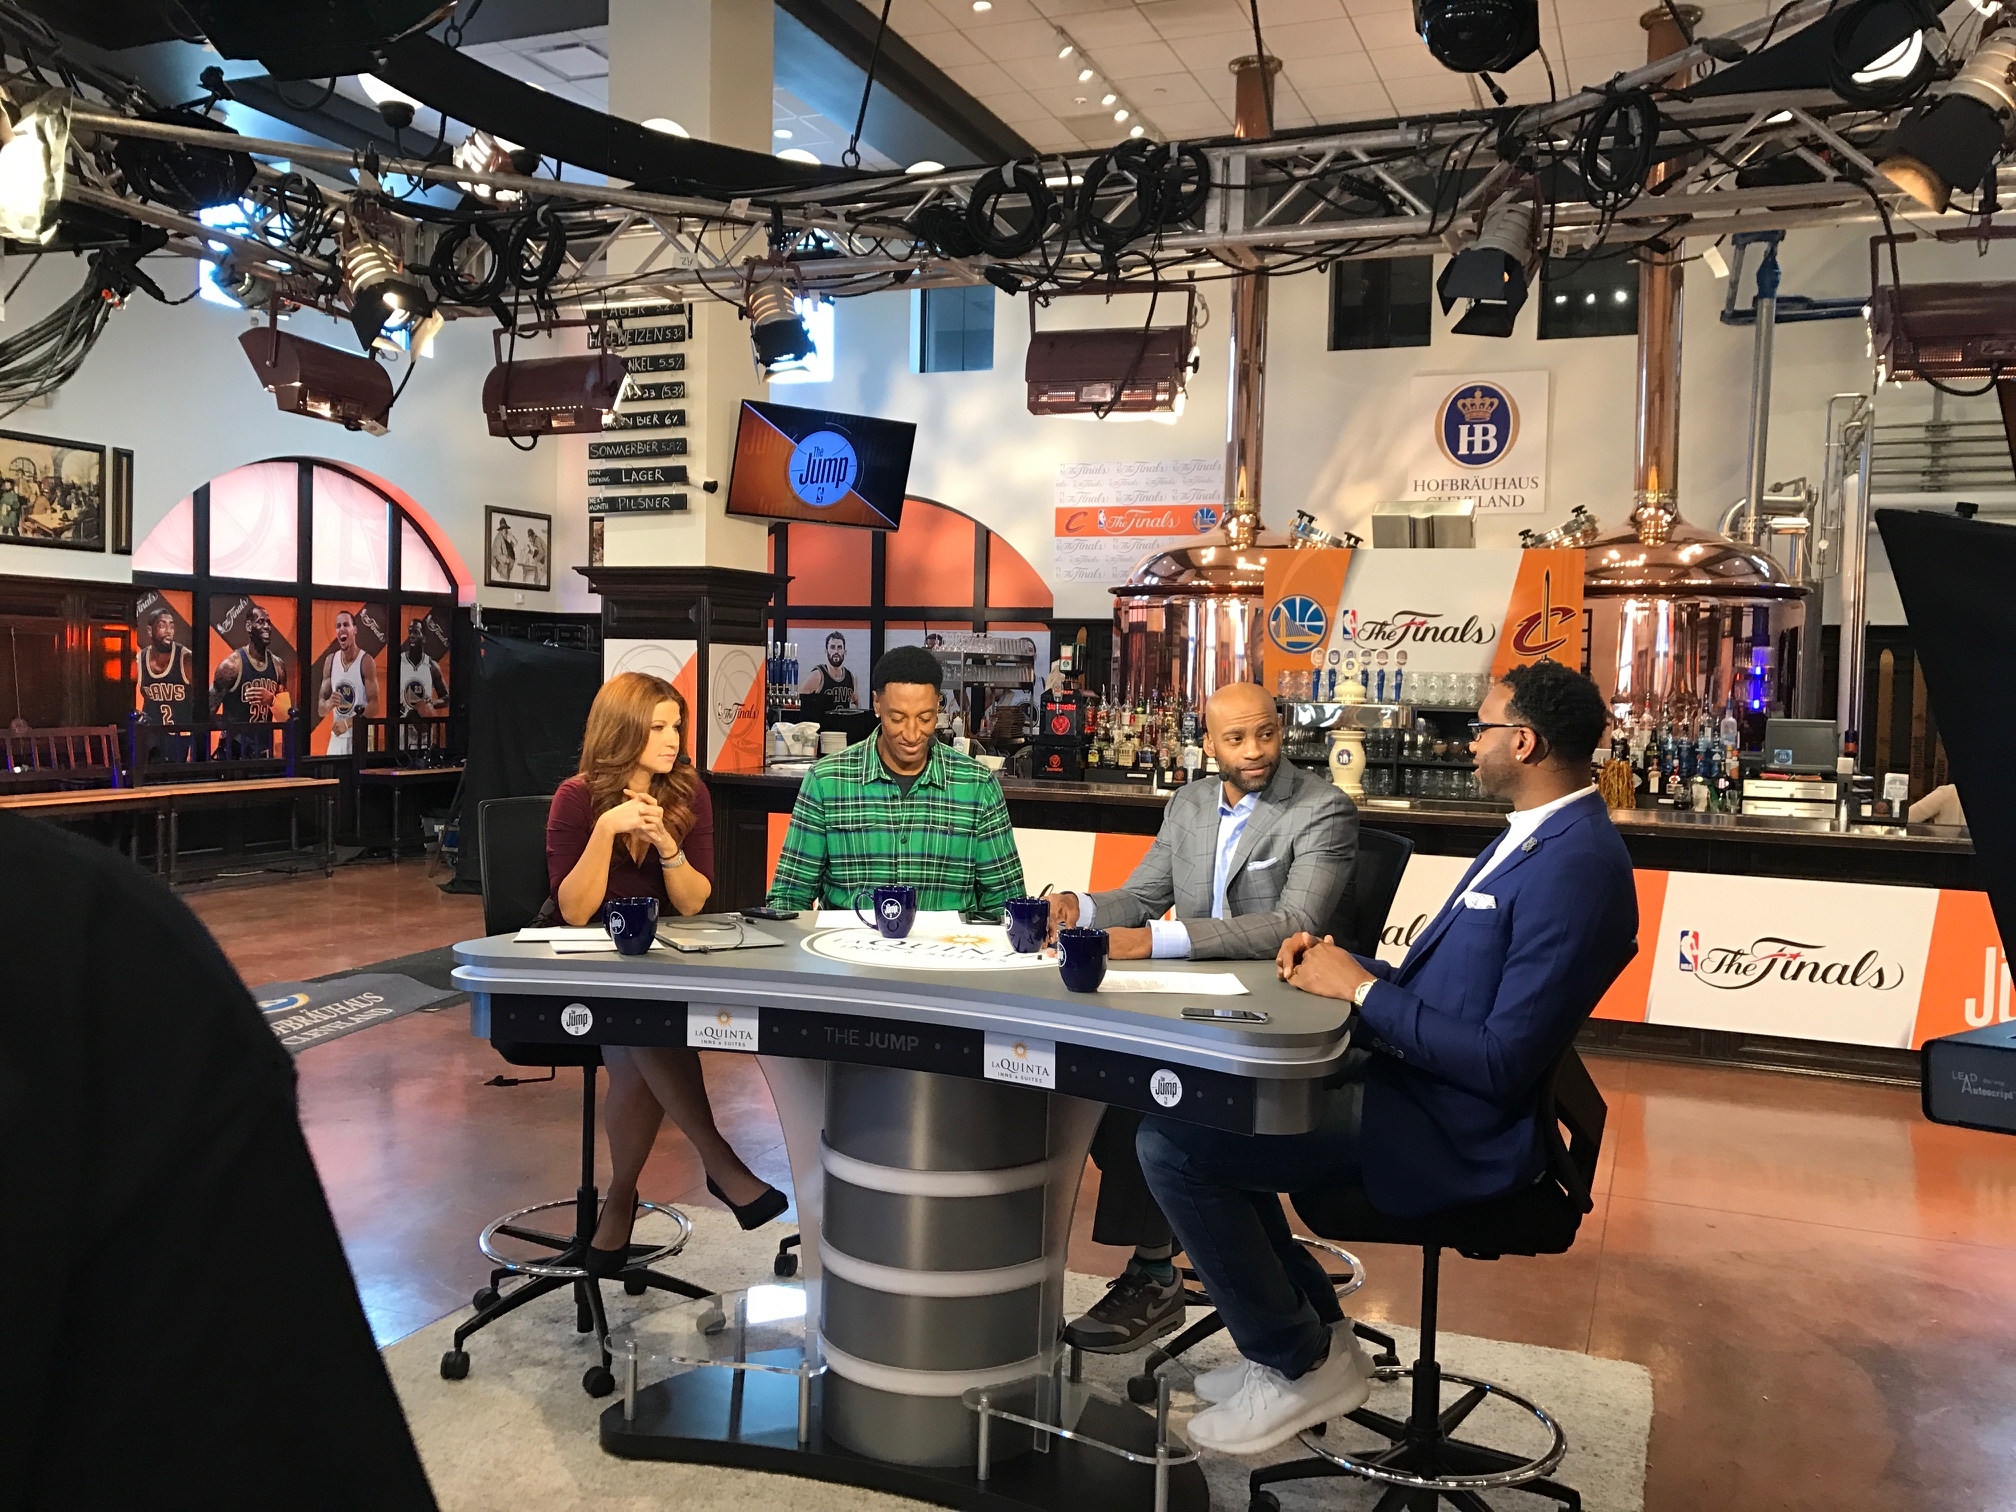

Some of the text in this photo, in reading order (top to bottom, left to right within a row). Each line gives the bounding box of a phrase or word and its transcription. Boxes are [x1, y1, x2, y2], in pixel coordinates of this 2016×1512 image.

[601, 305, 645, 318] LAGER
[589, 327, 664, 347] HEWEIZEN
[628, 357, 654, 371] NKEL
[636, 413, 660, 426] BIER
[1457, 423, 1498, 455] HB
[813, 446, 824, 457] The
[622, 469, 665, 483] LAGER
[799, 452, 849, 488] Jump
[1413, 476, 1539, 492] HOFBRÄUHAUS
[618, 497, 671, 511] PILSNER
[1106, 509, 1180, 532] The Finals
[1357, 610, 1496, 648] The Finals
[728, 703, 759, 721] Finals
[1700, 937, 1904, 989] The Finals
[270, 992, 384, 1036] FBRÄUHAUS
[566, 1013, 588, 1027] Jump
[823, 1027, 920, 1051] THE JUMP
[1155, 1079, 1178, 1098] Jump
